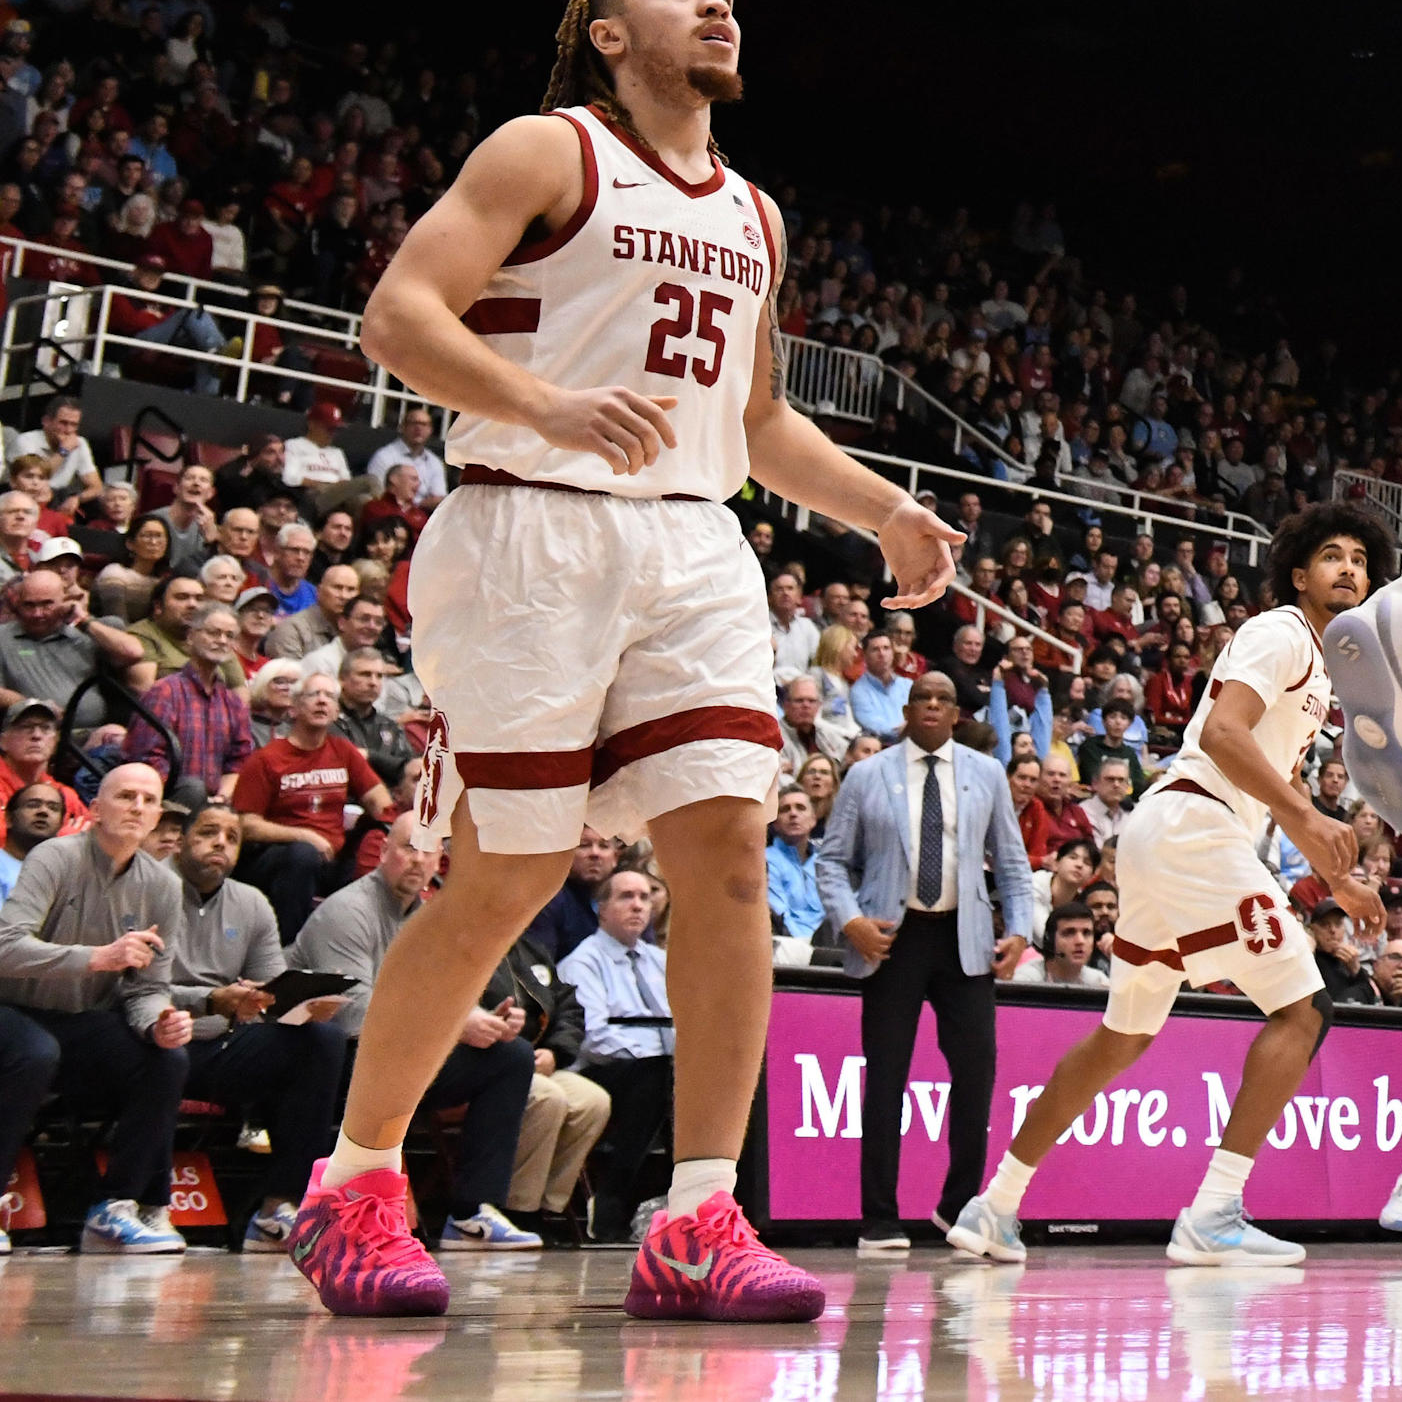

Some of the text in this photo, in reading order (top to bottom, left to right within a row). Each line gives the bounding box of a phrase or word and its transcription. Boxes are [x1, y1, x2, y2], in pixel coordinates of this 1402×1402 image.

[613, 224, 764, 297] STANFORD
[644, 281, 735, 389] 25
[170, 1190, 209, 1212] GO
